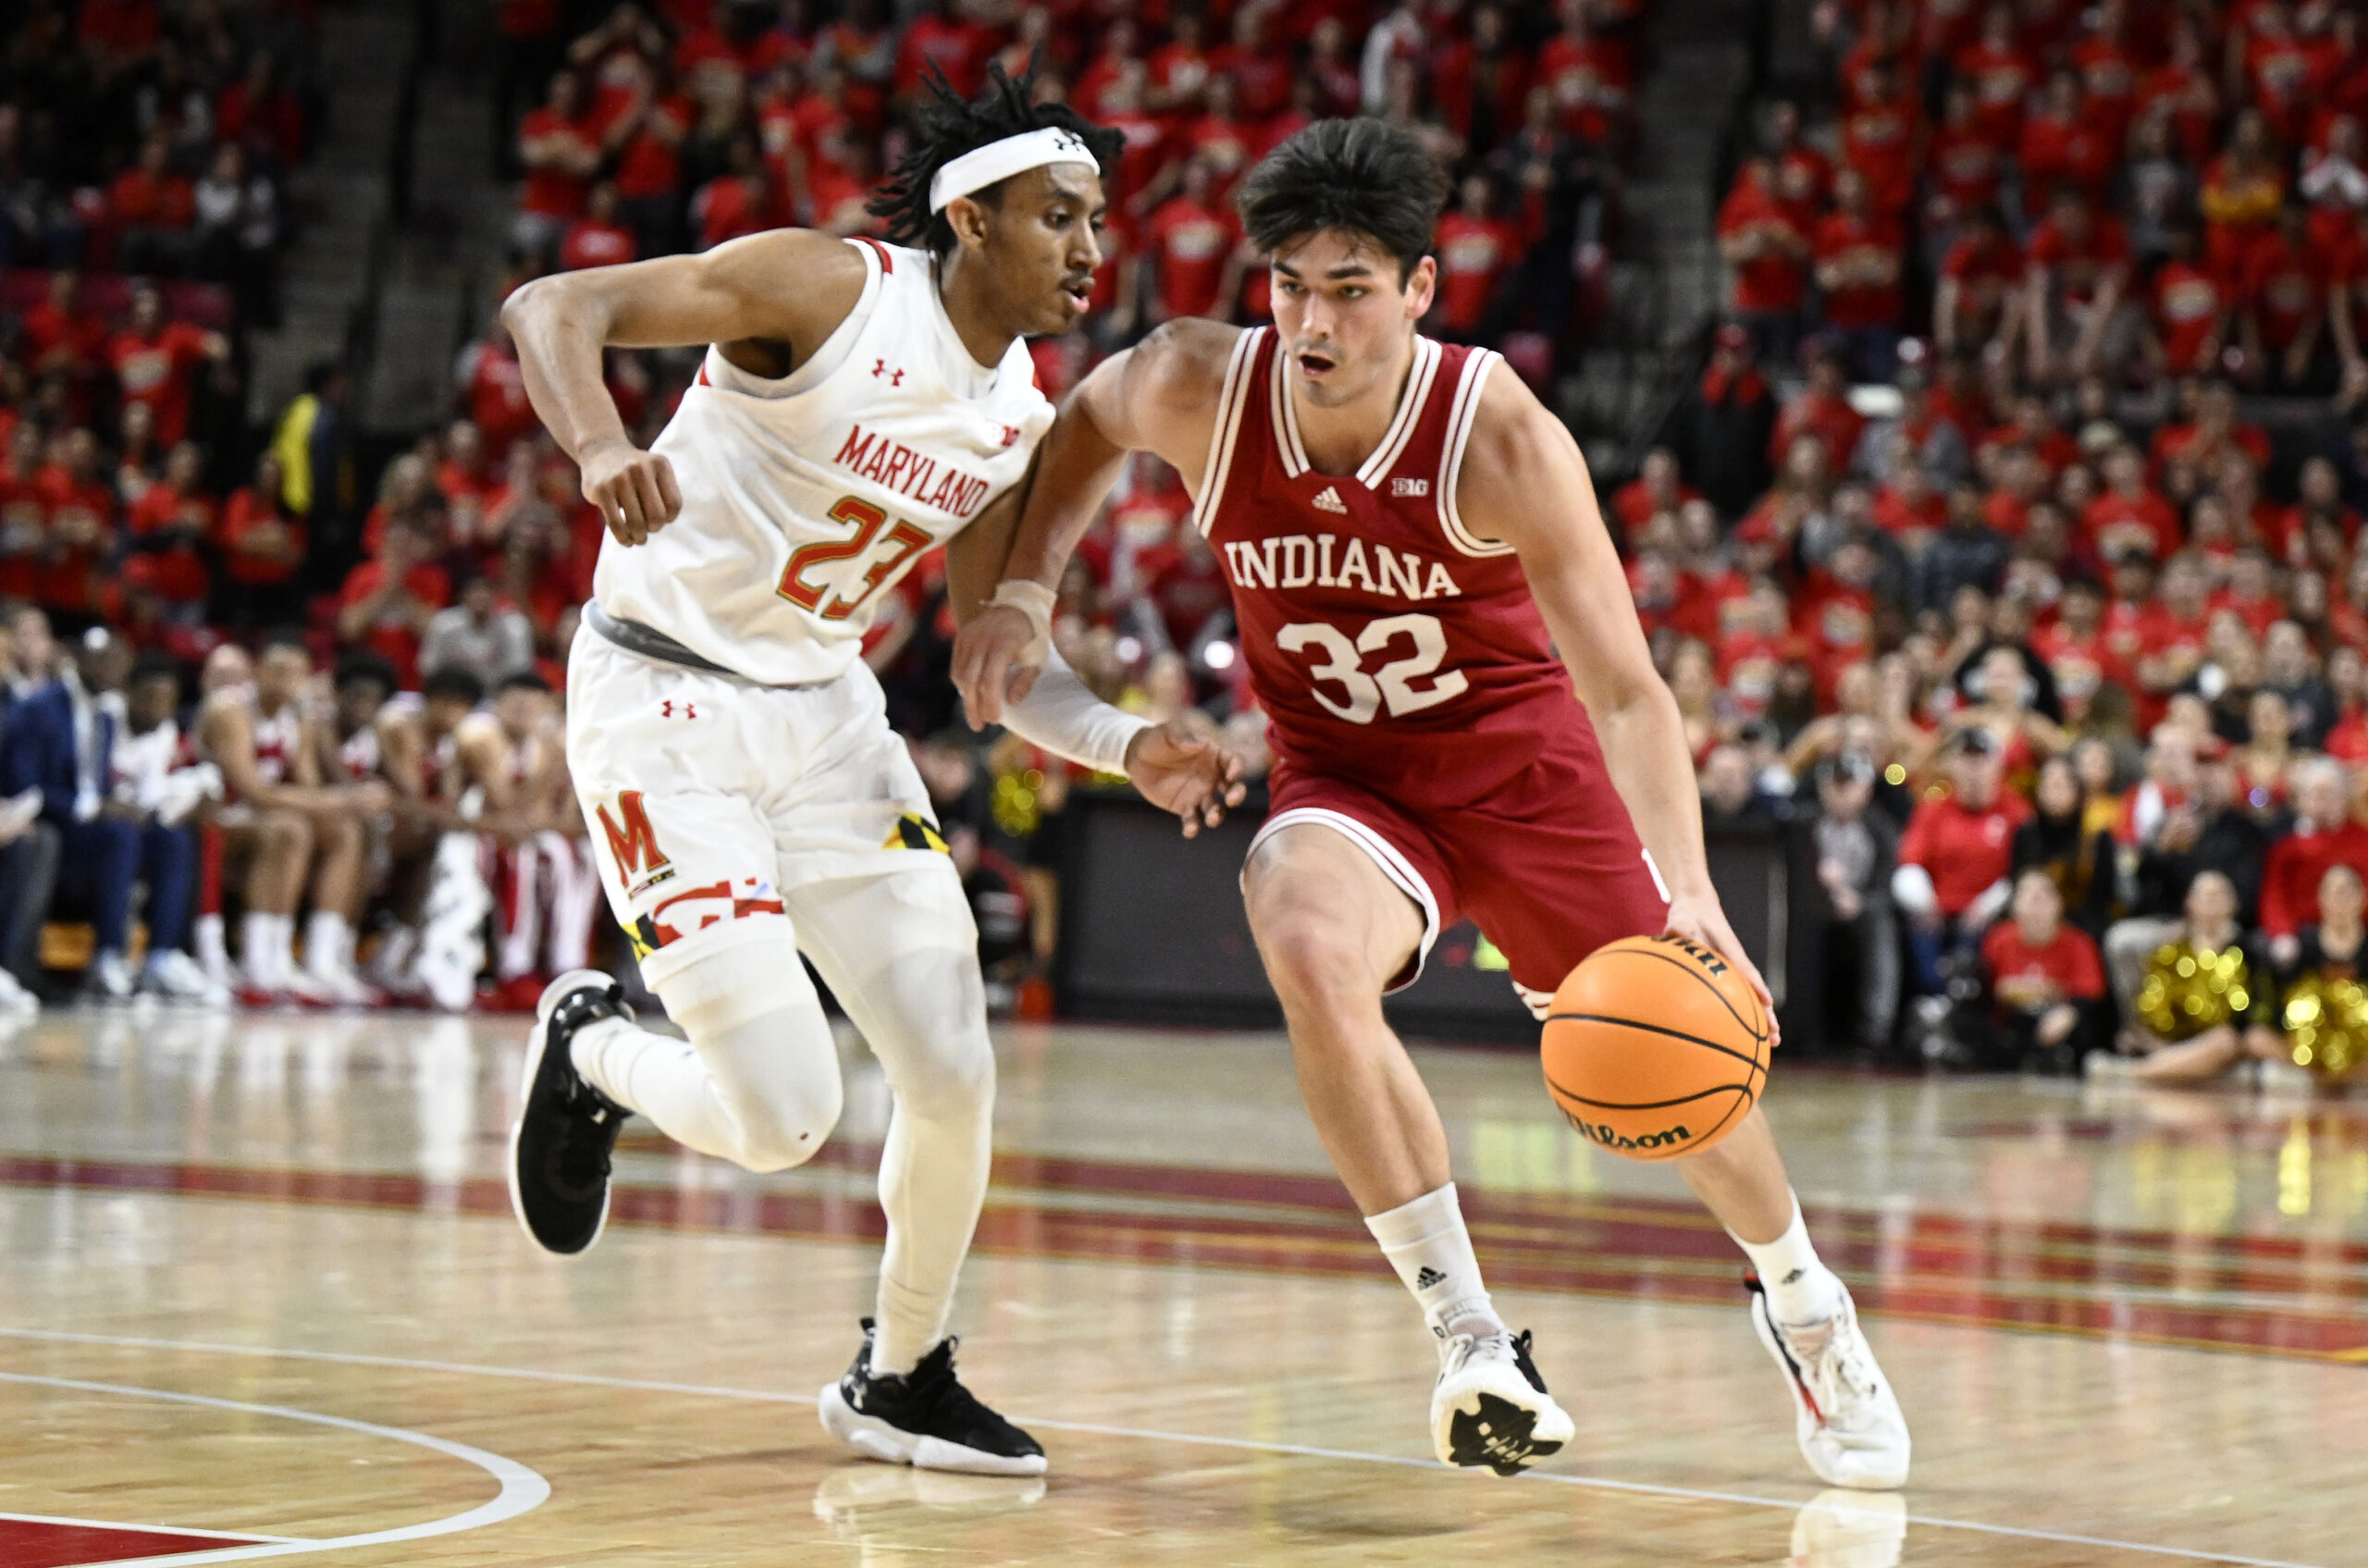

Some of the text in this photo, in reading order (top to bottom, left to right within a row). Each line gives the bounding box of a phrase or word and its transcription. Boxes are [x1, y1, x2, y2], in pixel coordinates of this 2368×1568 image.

[834, 424, 989, 518] MARYLAND
[776, 495, 934, 620] 23
[1224, 534, 1462, 601] INDIANA
[1276, 612, 1469, 724] 32
